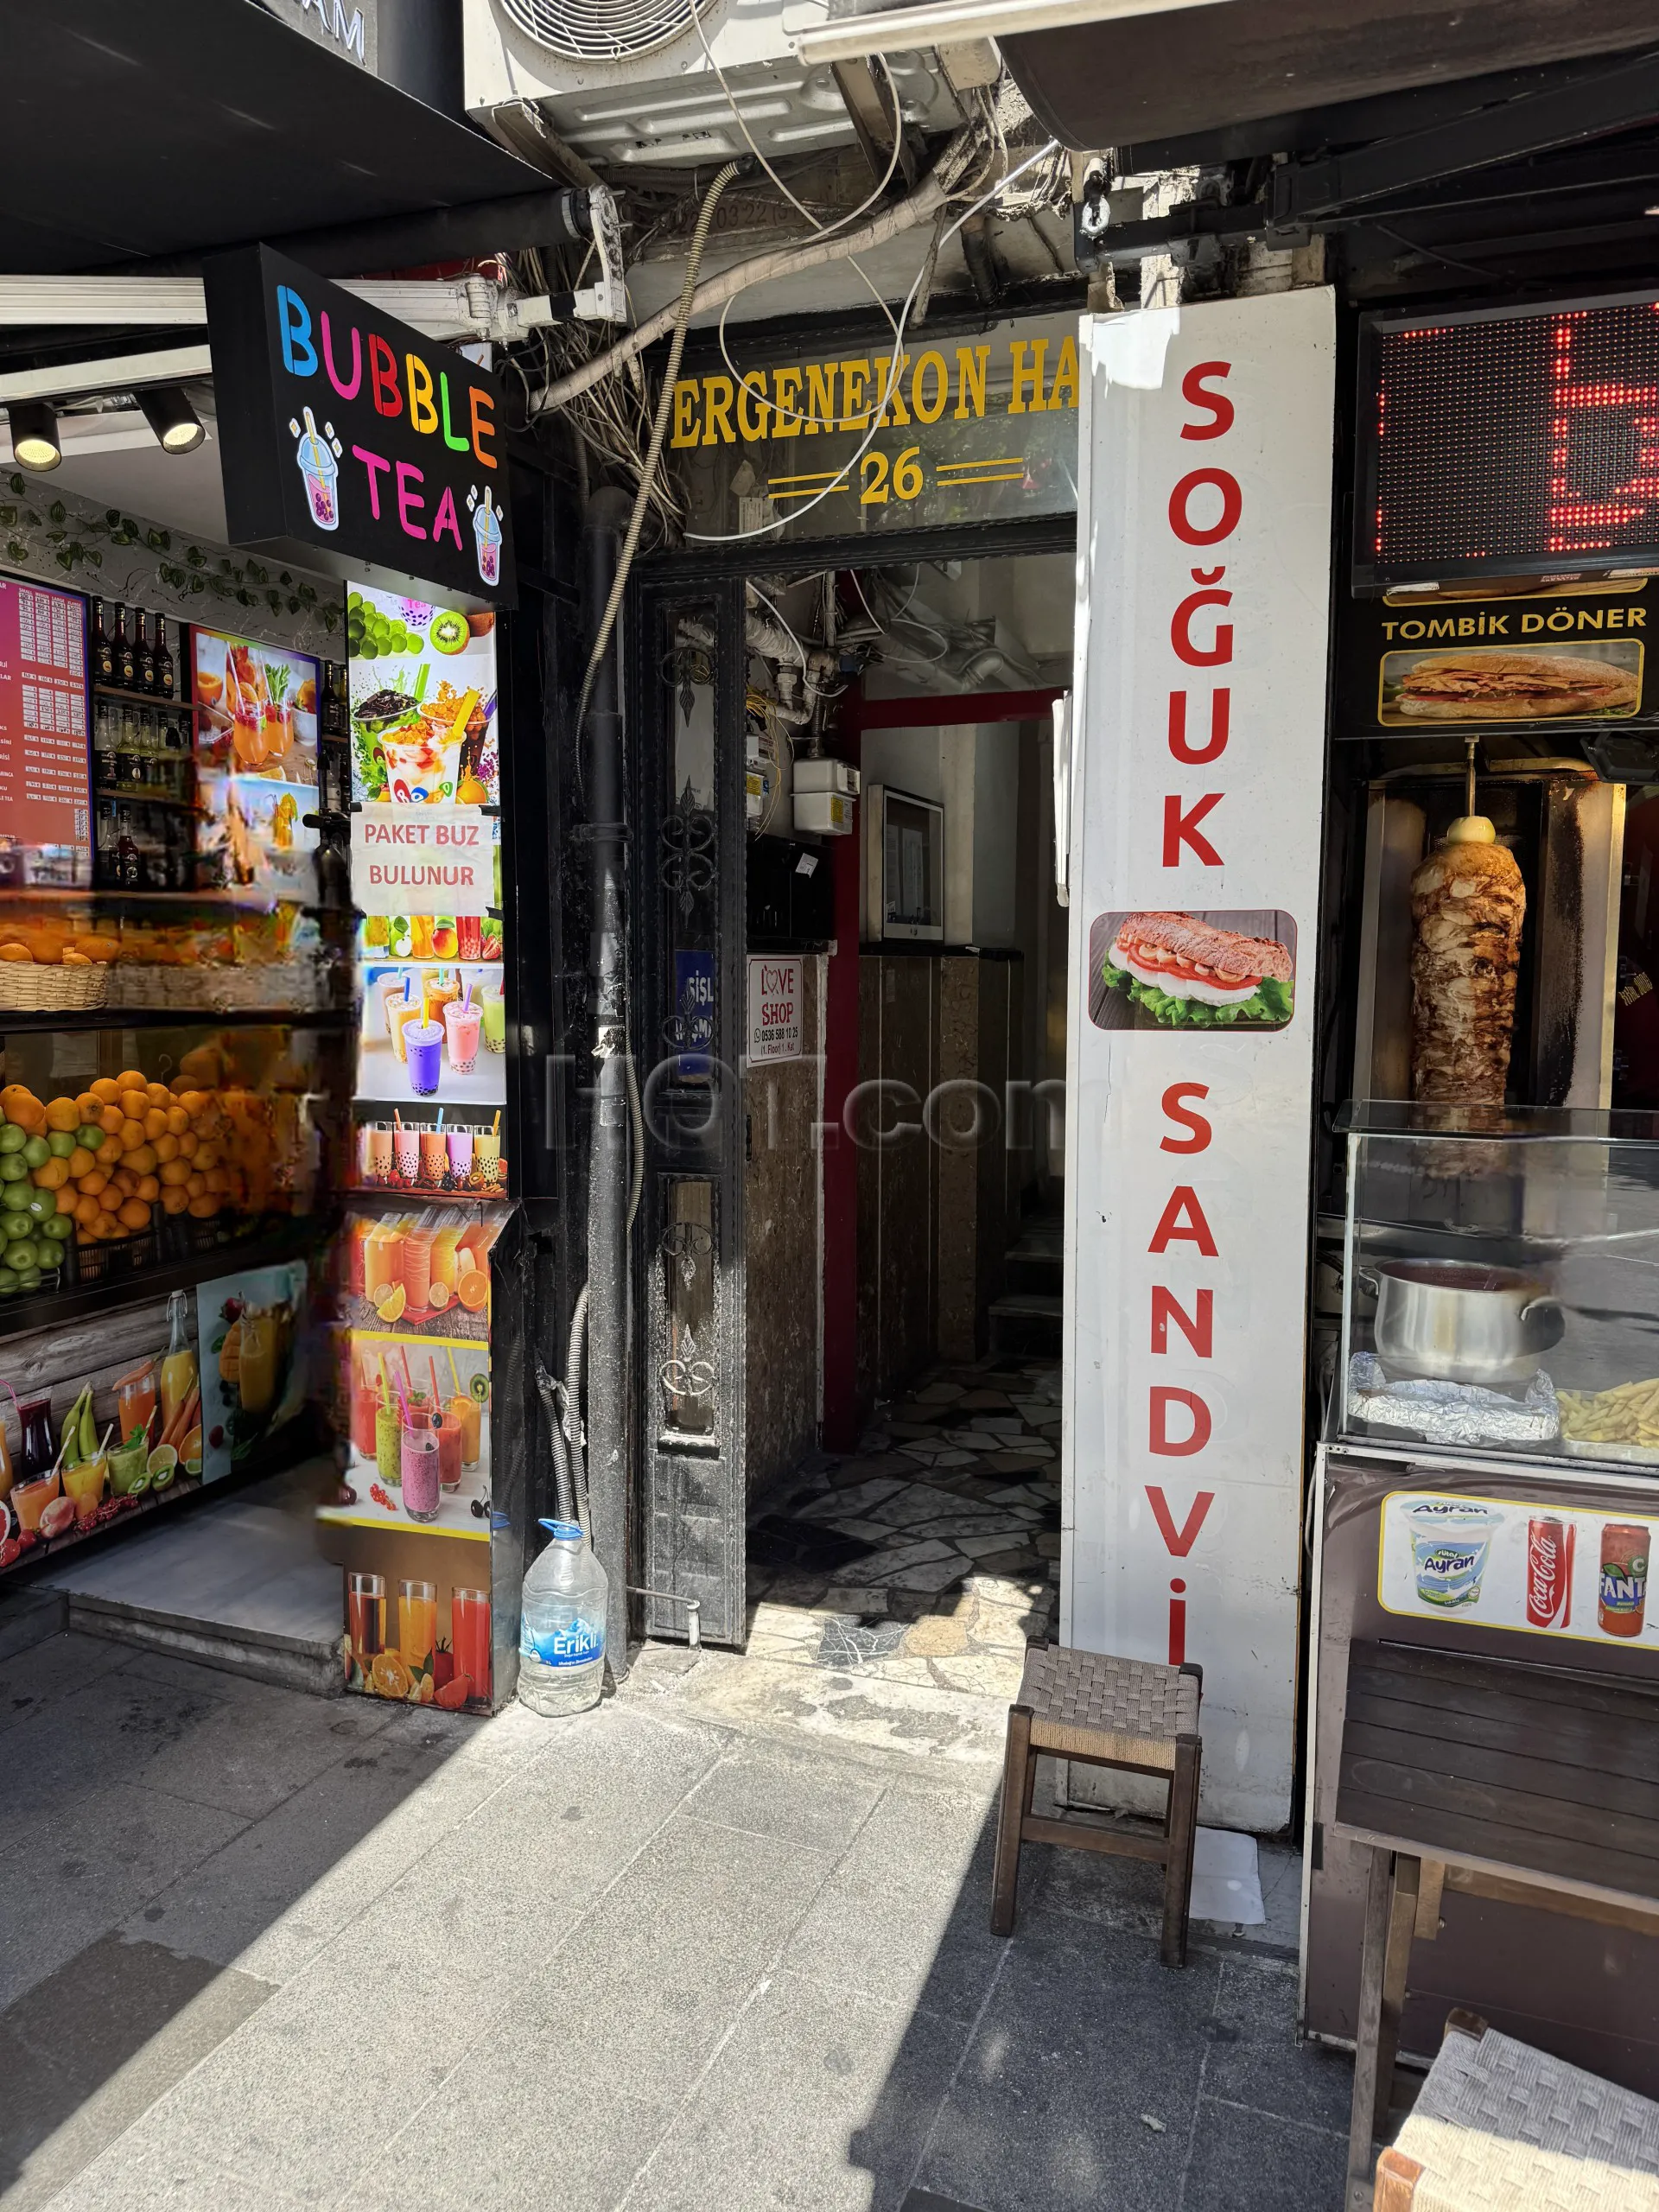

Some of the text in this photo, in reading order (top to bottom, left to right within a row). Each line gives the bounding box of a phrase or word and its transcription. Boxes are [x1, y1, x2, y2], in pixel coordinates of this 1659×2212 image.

[277, 284, 498, 469] BUBBLE
[671, 345, 991, 449] ERGENEKON
[860, 446, 924, 505] 26
[353, 445, 463, 551] TEA
[1162, 360, 1243, 868] SOĞUK
[1382, 607, 1647, 640] TOMBİK DÖNER
[365, 823, 480, 847] PAKET BUZ
[369, 865, 474, 887] BULUNUR
[761, 1001, 794, 1027] SHOP
[761, 1029, 775, 1042] 0536
[1146, 1082, 1218, 1668] SANDVİ
[1413, 1504, 1488, 1515] Ayran
[1425, 1555, 1475, 1573] Ayran
[554, 1631, 598, 1655] Erikli
